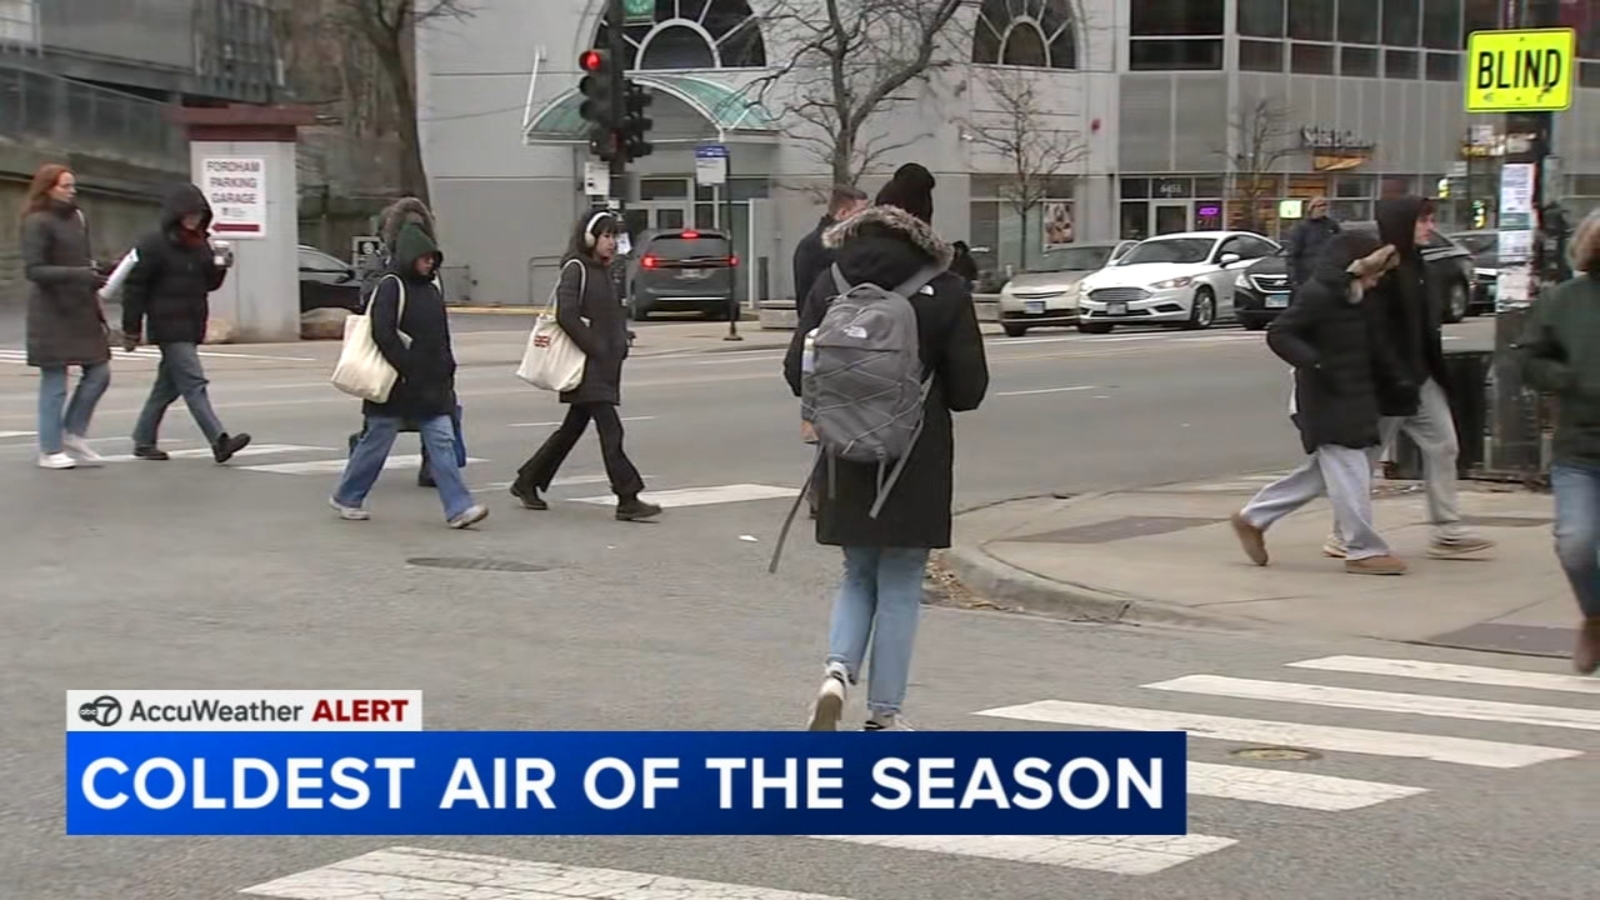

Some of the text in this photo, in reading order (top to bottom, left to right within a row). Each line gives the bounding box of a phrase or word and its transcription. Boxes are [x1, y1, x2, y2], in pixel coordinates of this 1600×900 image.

[1477, 49, 1562, 89] BLIND
[206, 161, 260, 172] FORDHAM
[210, 177, 257, 189] PARKING
[211, 193, 257, 204] GARAGE
